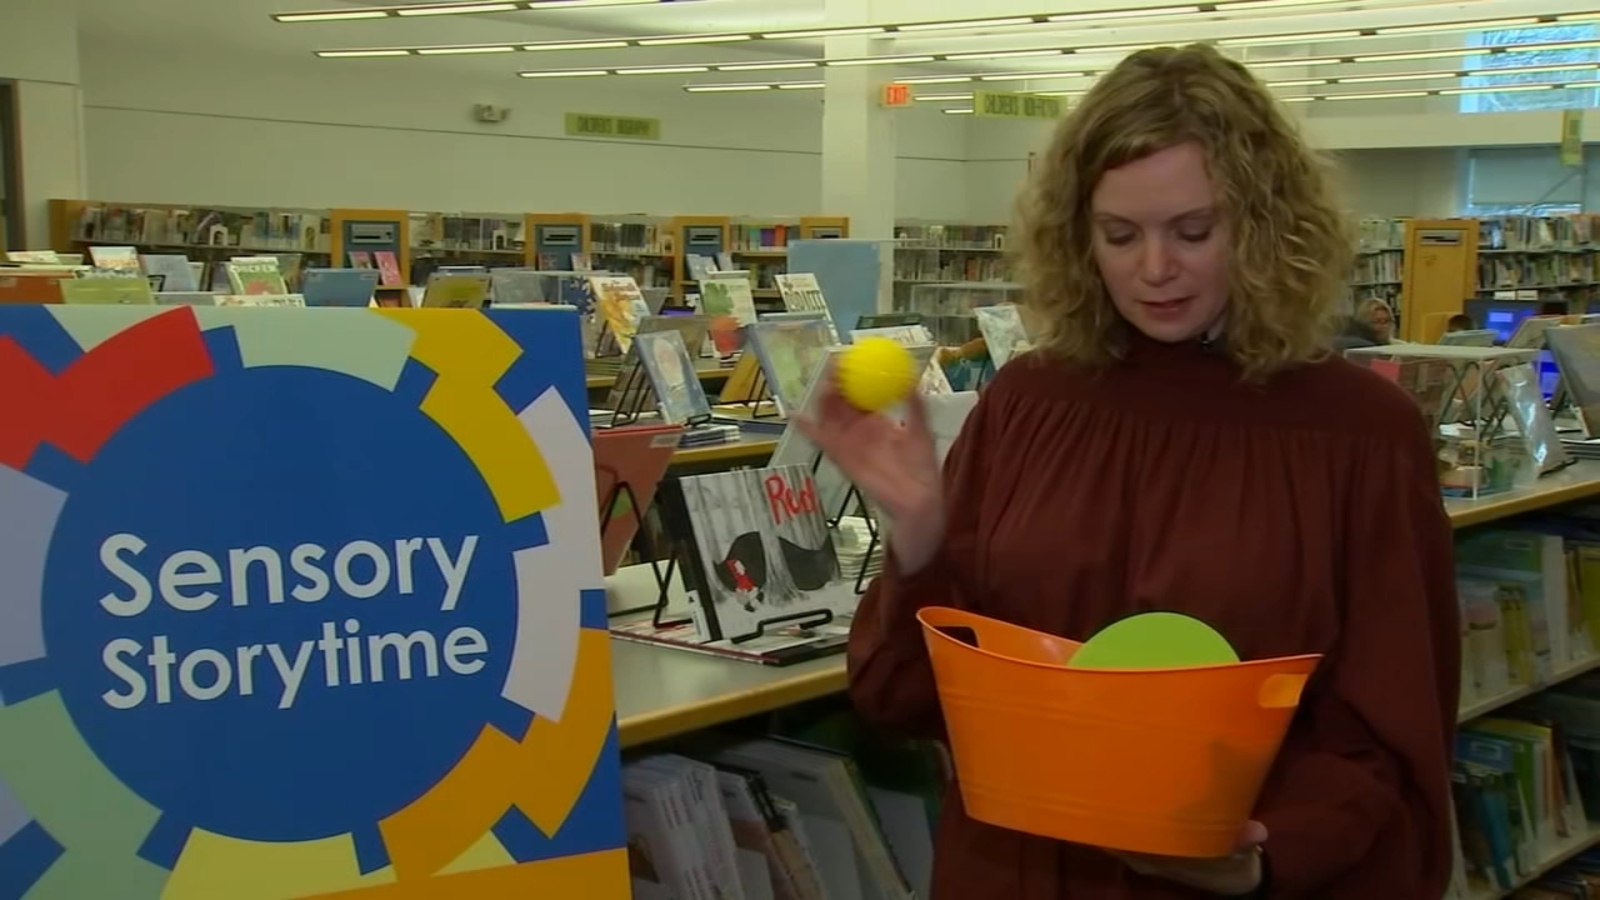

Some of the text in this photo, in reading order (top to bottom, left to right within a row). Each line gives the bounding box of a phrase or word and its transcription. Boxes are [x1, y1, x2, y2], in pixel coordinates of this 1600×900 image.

[764, 474, 818, 525] Red
[100, 533, 479, 617] Sensory
[102, 618, 489, 709] Storytime
